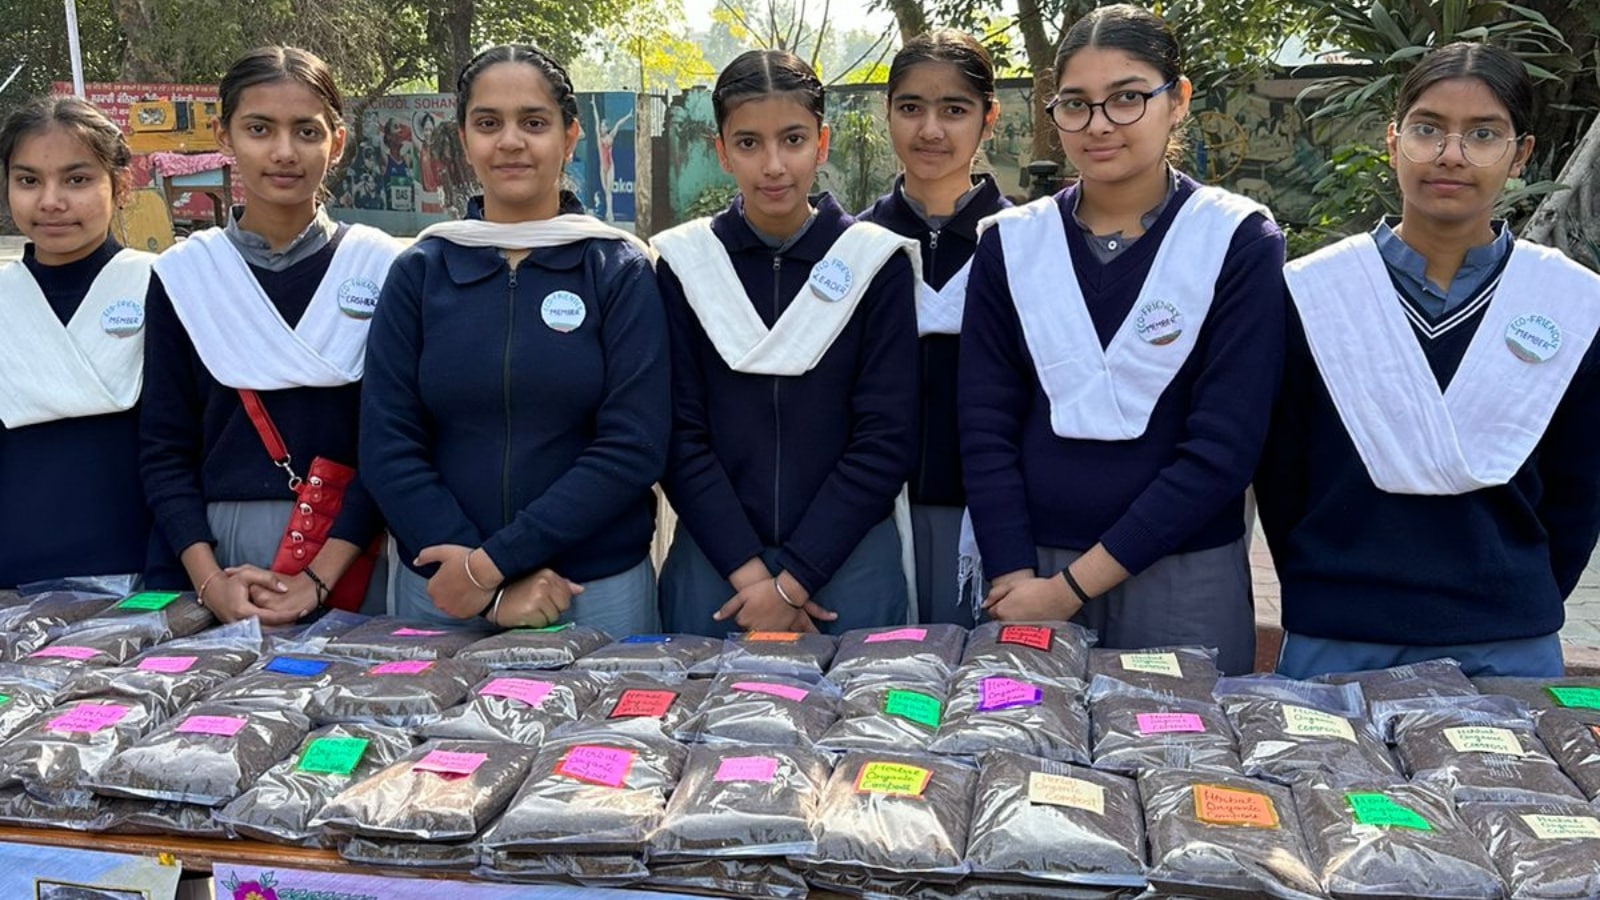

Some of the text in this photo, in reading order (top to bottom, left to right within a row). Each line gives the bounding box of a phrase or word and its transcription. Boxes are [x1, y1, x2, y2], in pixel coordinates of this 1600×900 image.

[812, 273, 847, 294] LEADER
[109, 316, 139, 325] MEMBER
[1514, 328, 1548, 350] MEMBER
